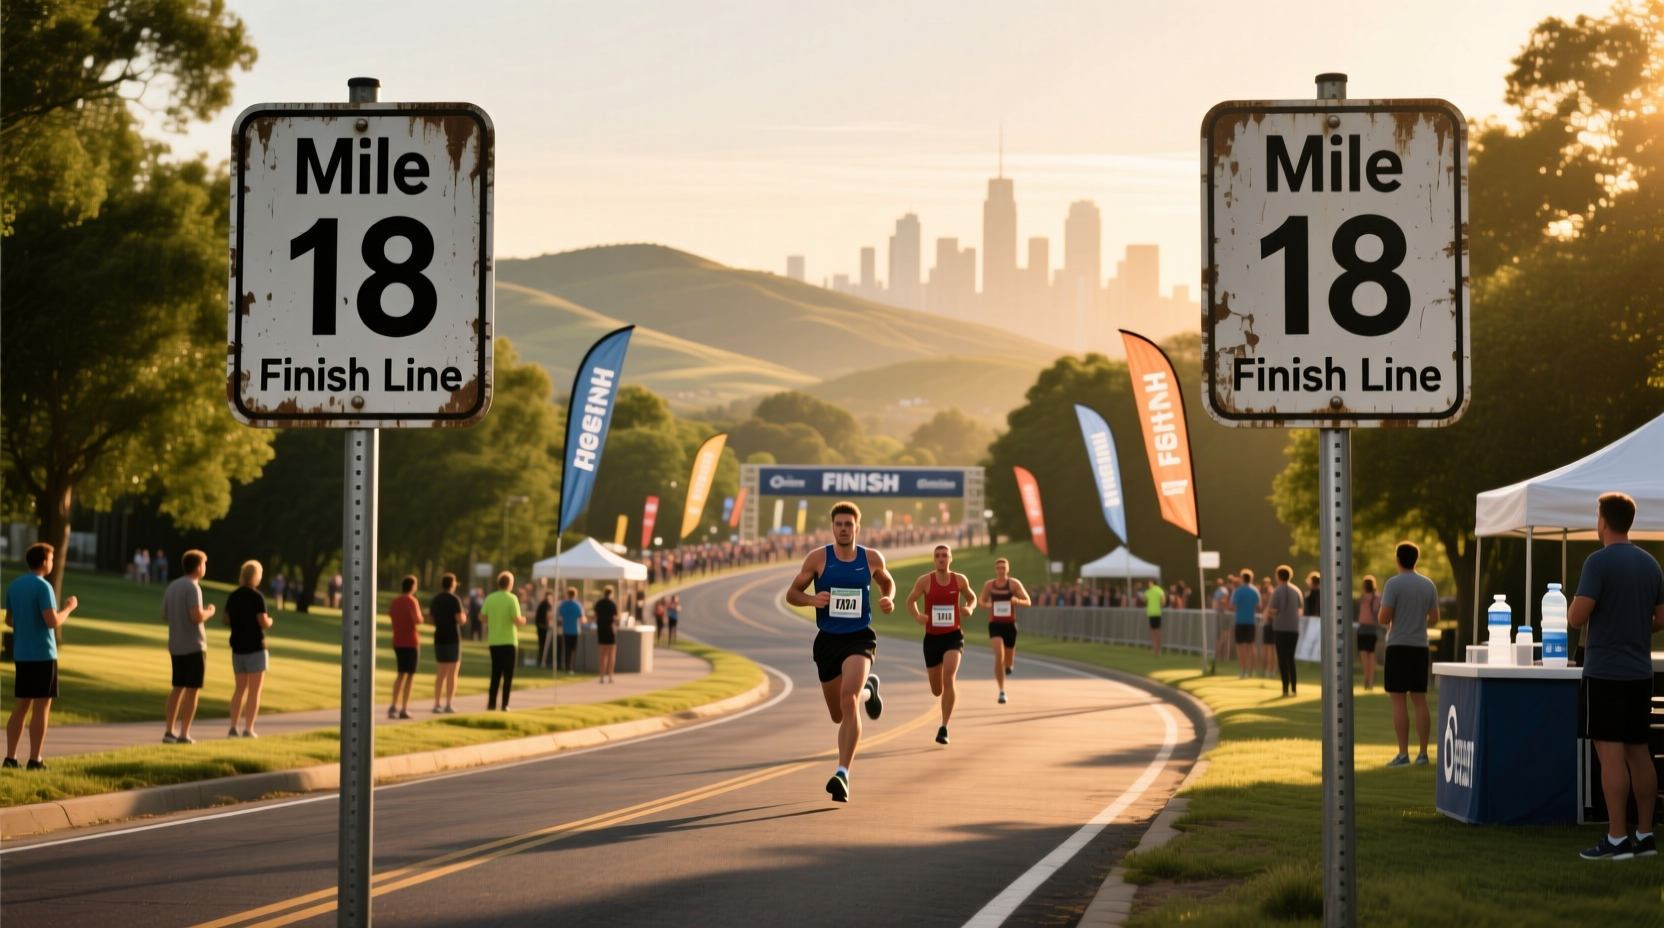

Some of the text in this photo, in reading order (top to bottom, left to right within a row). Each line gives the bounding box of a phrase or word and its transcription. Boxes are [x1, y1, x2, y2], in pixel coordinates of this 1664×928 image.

[296, 136, 430, 195] Mile
[1266, 134, 1403, 193] Mile
[290, 215, 438, 338] 18
[1260, 213, 1412, 337] 18
[260, 357, 463, 393] Finish Line
[1233, 356, 1442, 393] Finish Line
[822, 471, 900, 493] FINISH
